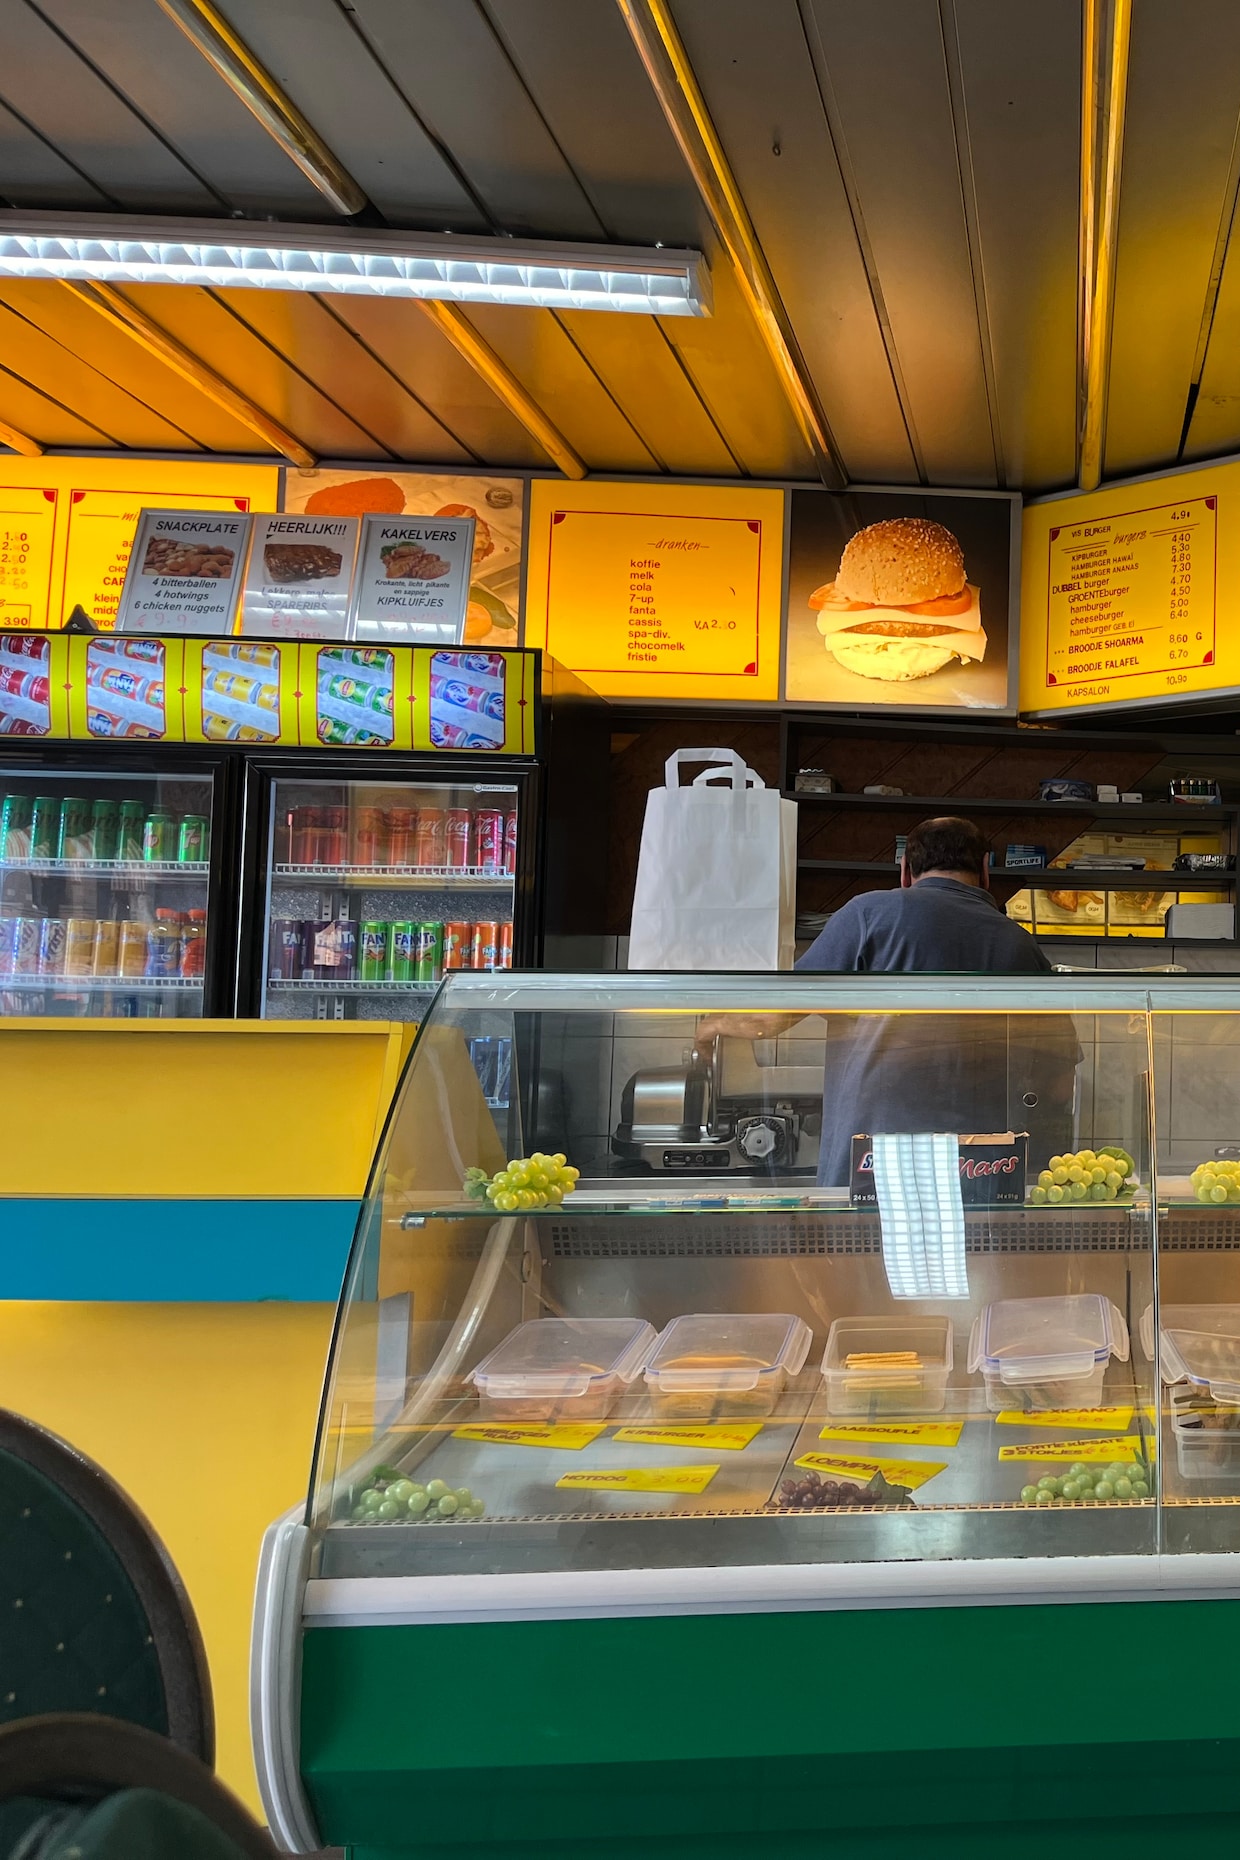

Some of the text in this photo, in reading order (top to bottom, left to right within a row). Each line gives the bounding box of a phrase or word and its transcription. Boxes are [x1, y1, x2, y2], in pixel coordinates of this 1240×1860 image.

[156, 520, 239, 534] SNACKPLATE
[267, 521, 347, 536] HEERLIJK!!!
[1084, 525, 1111, 537] BURGER
[380, 528, 457, 541] KAKELVERS
[1113, 530, 1147, 545] burgers
[1171, 533, 1191, 543] 4.40
[655, 538, 701, 551] dranken
[630, 559, 661, 569] koffie
[1071, 558, 1111, 572] HAMBURGER
[630, 571, 655, 580] melk
[1071, 567, 1111, 581] HAMBURGER
[1112, 562, 1139, 574] ANANAS
[152, 578, 217, 589] 4 bitterballen
[1052, 581, 1082, 595] DUBBEL
[1084, 577, 1110, 590] burger
[1170, 575, 1191, 585] 4.70
[630, 582, 652, 592] cola
[155, 590, 209, 601] 4 hotwings
[629, 594, 654, 604] 7-up
[1070, 586, 1190, 615] hamburger 4.50
[134, 600, 225, 614] 6 chicken nuggets
[377, 597, 444, 608] KIPKLUIFJES
[629, 605, 656, 615] fanta
[1070, 598, 1189, 626] cheeseburger 5.00
[628, 618, 662, 627] cassis
[1069, 623, 1112, 638] hamburger
[1169, 609, 1189, 620] 6.40
[628, 630, 671, 640] spa-div.
[627, 641, 685, 651] chocomelk
[1068, 641, 1103, 655] BROODJE
[1105, 636, 1144, 649] SHOARMA
[1169, 634, 1188, 644] 8.60
[627, 652, 658, 662] fristie
[1067, 650, 1188, 675] BROODJE FALAFEL 6.70
[1067, 685, 1110, 698] KAPSALON
[805, 1456, 880, 1471] LOEMPIA
[562, 1474, 628, 1482] HOTDOG
